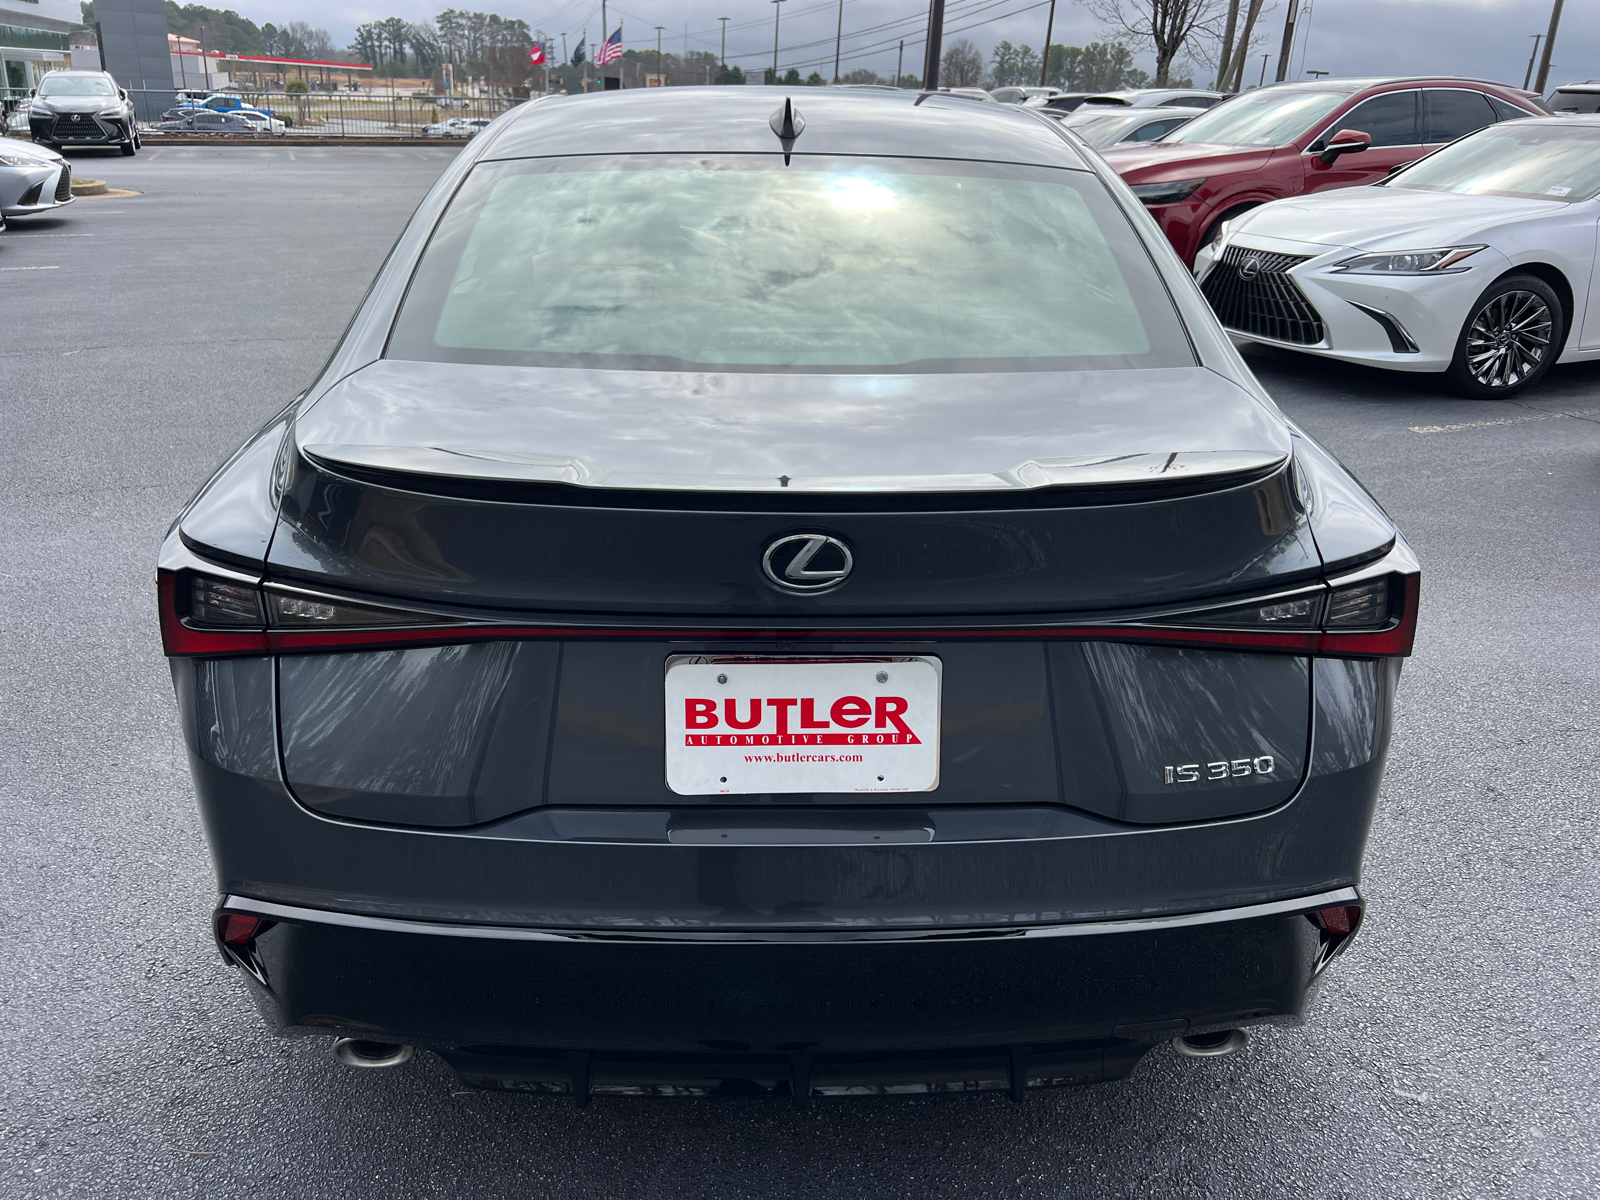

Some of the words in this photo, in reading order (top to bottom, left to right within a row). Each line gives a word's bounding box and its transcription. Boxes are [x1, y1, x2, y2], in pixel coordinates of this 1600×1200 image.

[686, 734, 823, 745] AUTOMOTIVE
[847, 733, 913, 744] GROUP
[744, 752, 863, 763] www.butlercars.com
[1164, 764, 1200, 784] IS
[1207, 755, 1275, 780] 350
